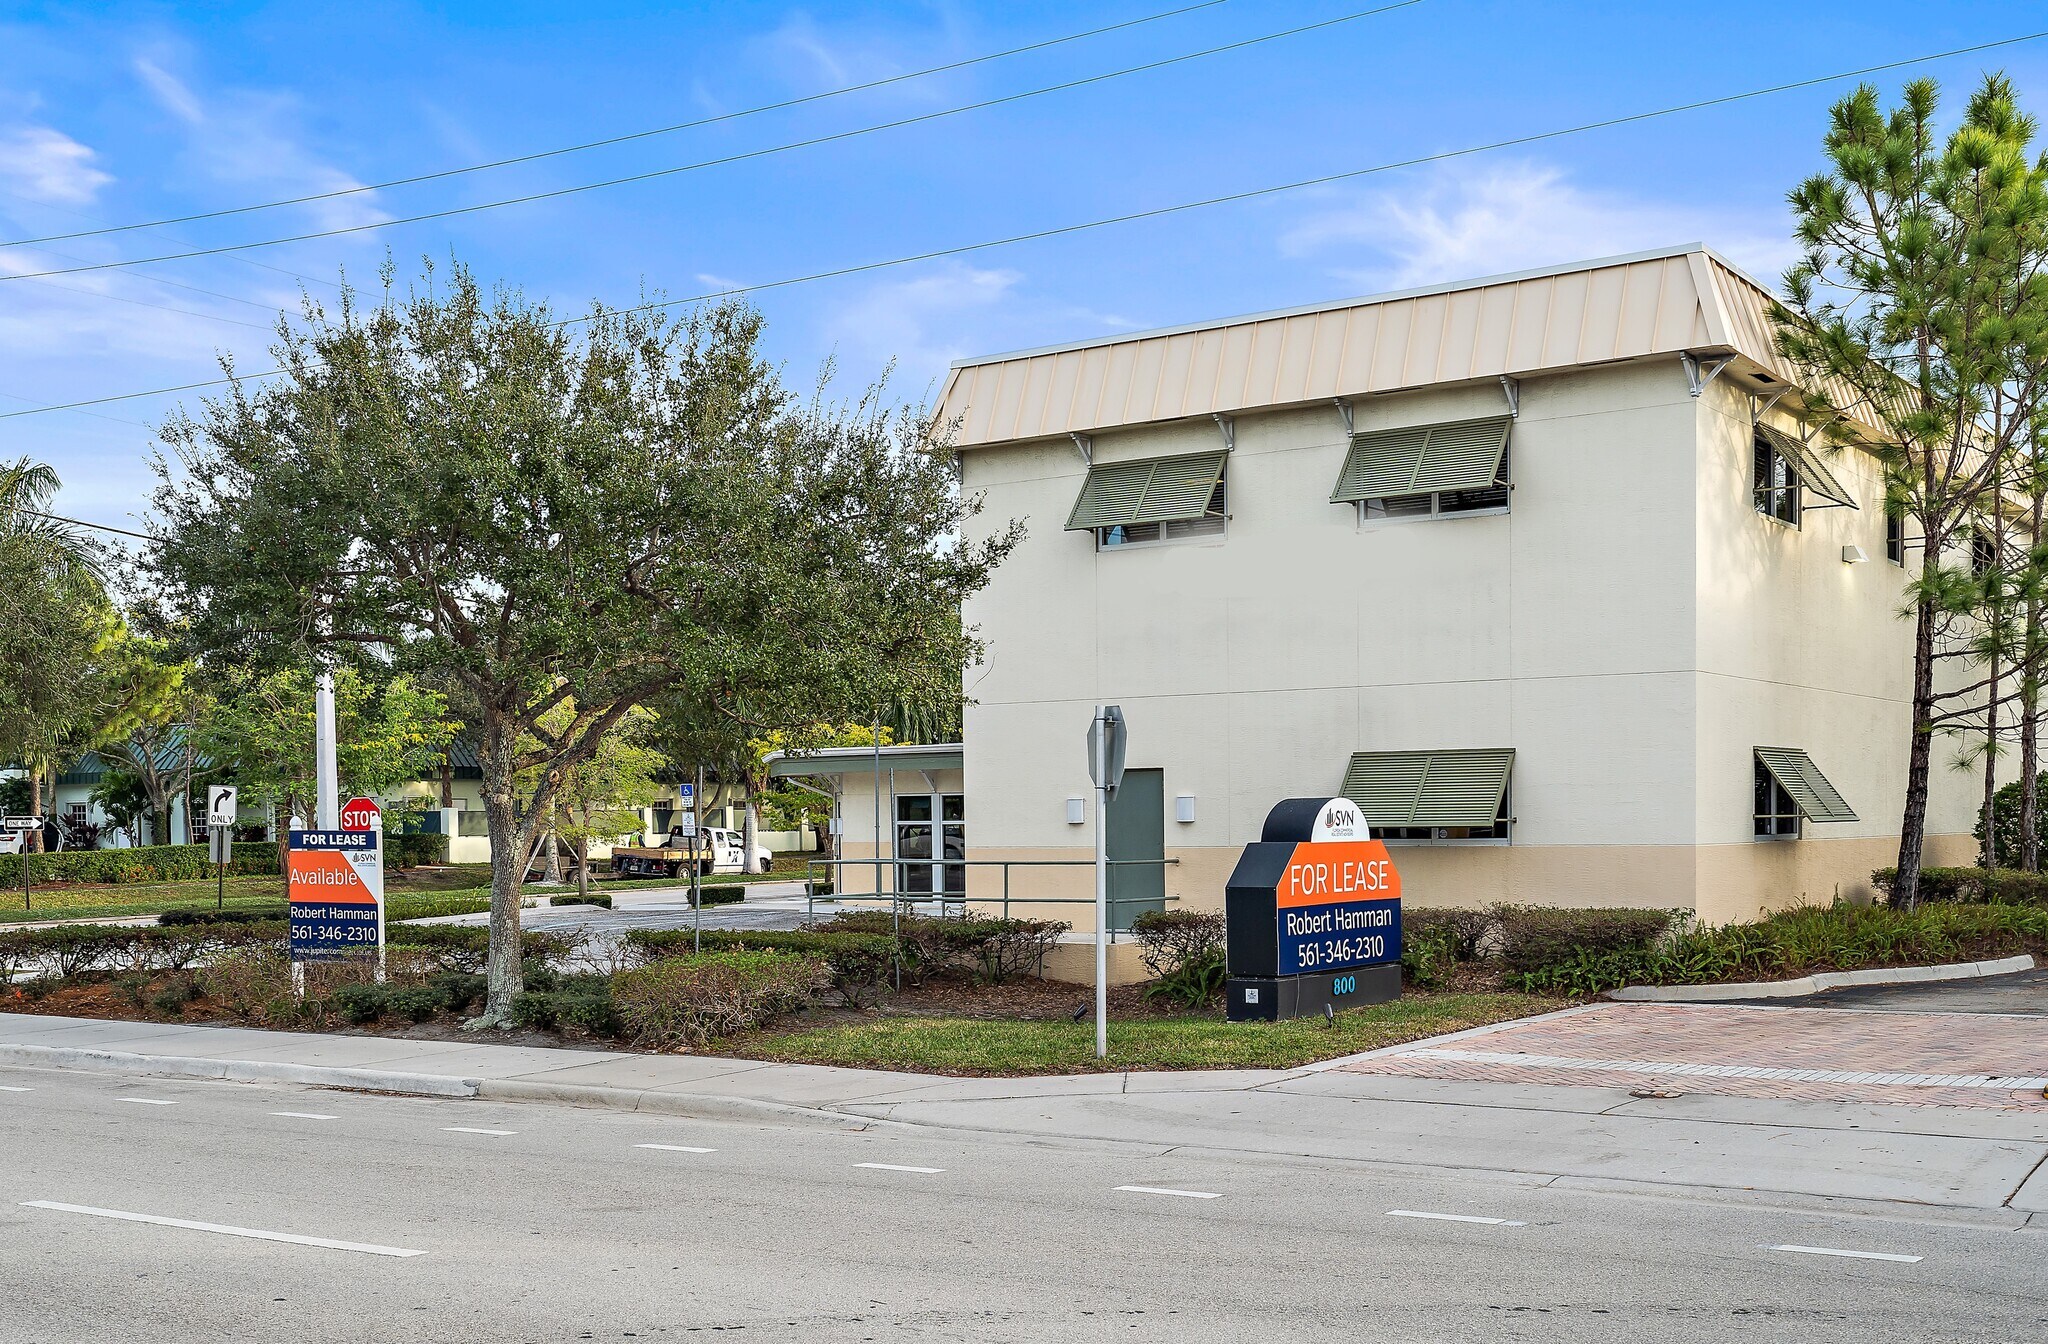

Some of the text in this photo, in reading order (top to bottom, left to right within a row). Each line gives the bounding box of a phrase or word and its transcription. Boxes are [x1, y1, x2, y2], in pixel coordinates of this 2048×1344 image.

[210, 814, 234, 824] ONLY
[1335, 810, 1354, 826] SVN
[302, 834, 367, 846] FOR LEASE
[360, 853, 377, 862] SVN
[290, 868, 358, 886] Available
[1291, 860, 1389, 896] FOR LEASE
[290, 906, 377, 920] Robert Hamman
[1287, 908, 1392, 937] Robert Hamman
[291, 925, 377, 942] 561-346-2310
[1298, 935, 1384, 967] 561-346-2310
[1333, 976, 1355, 995] 800
